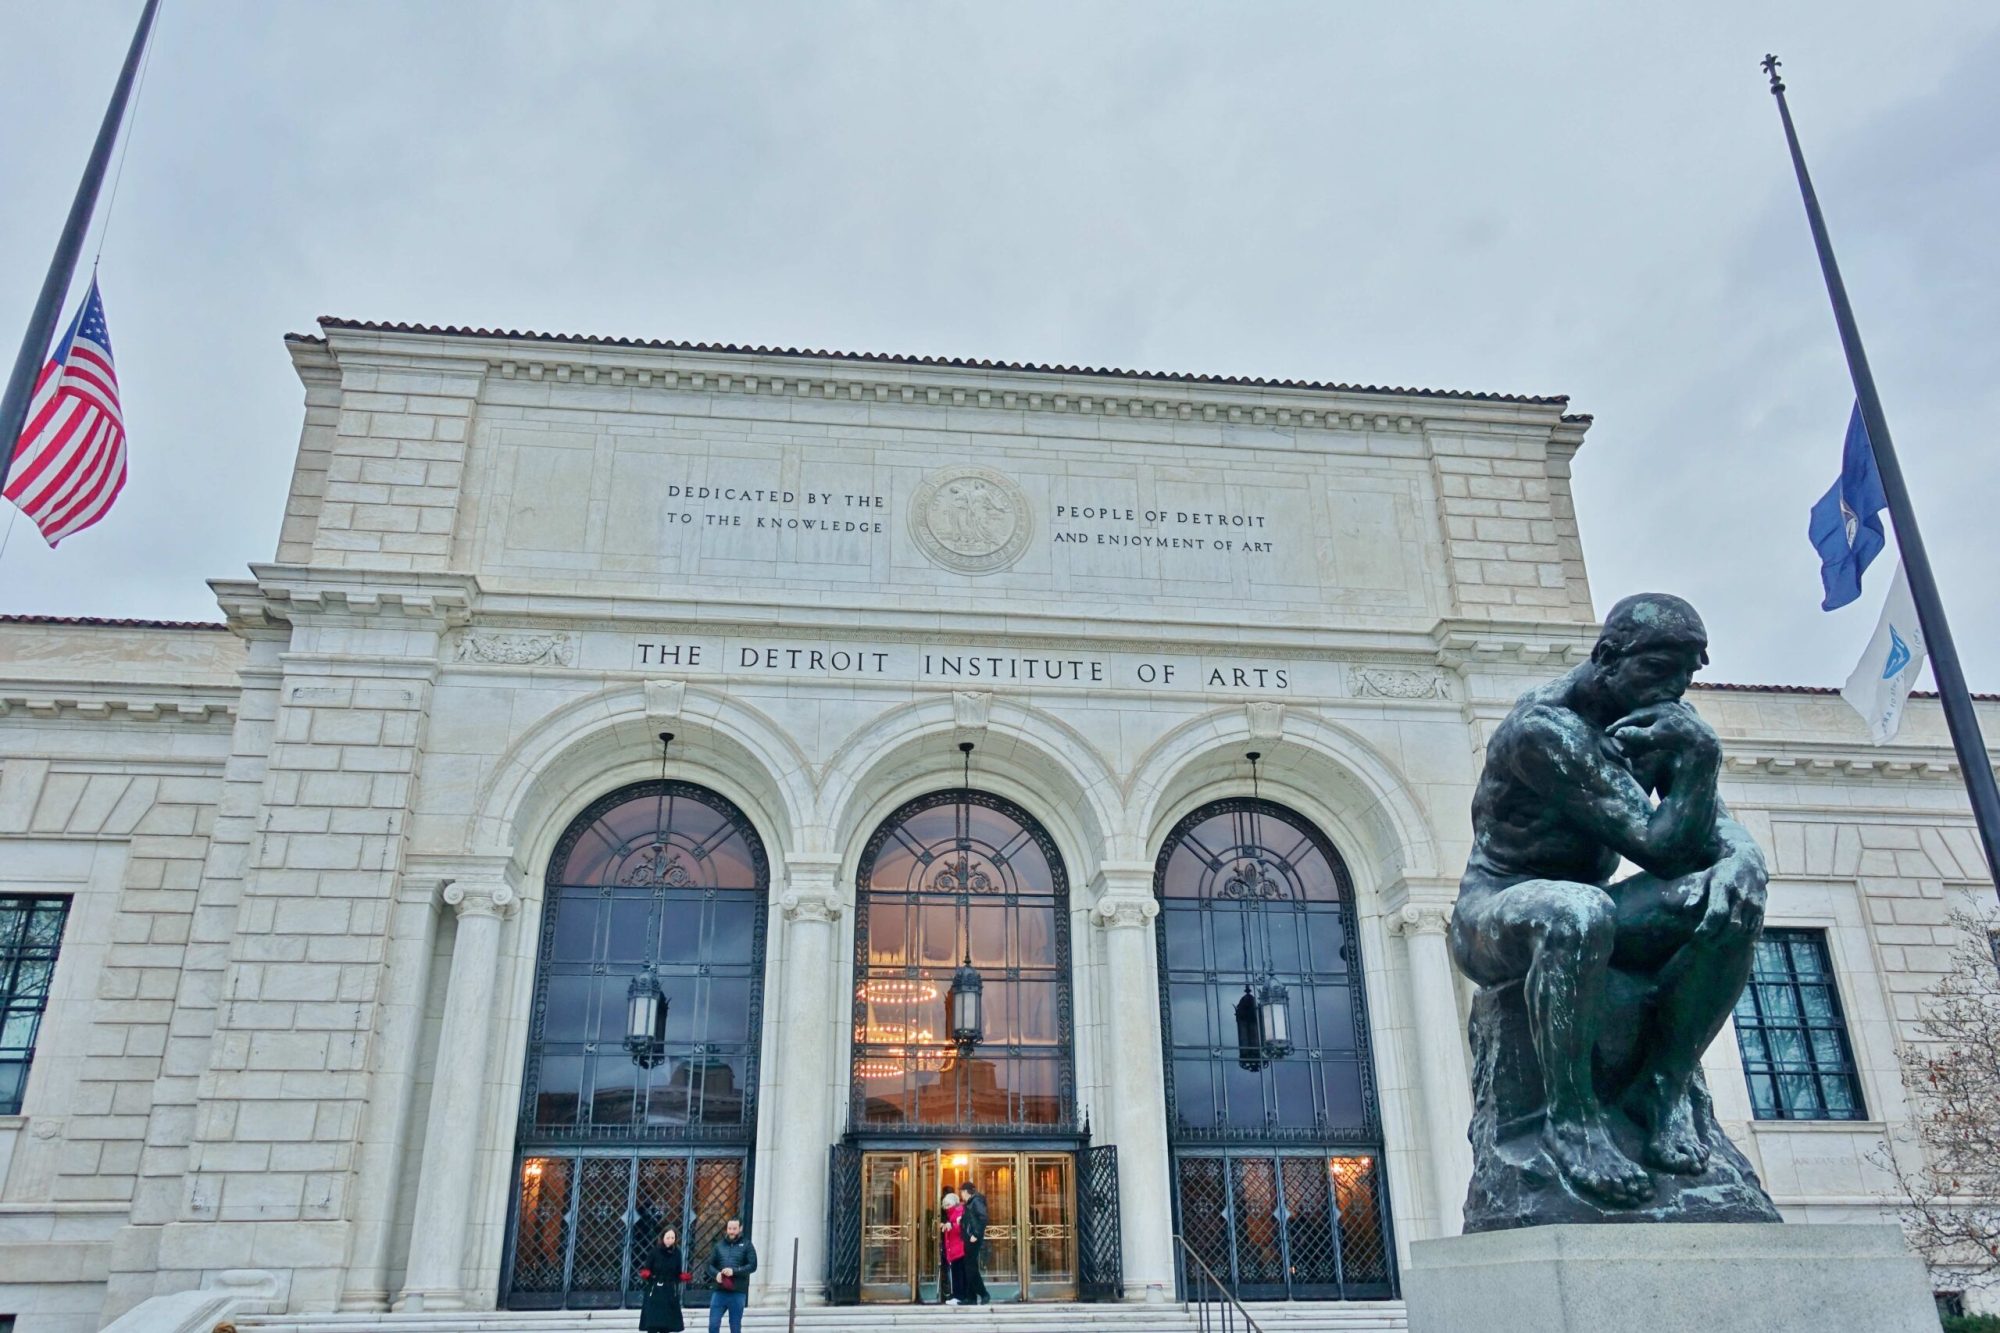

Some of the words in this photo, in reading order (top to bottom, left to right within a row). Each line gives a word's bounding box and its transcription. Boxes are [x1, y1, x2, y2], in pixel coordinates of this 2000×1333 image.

[668, 485, 795, 503] DEDICATED
[807, 492, 833, 505] BY
[844, 494, 884, 509] THE
[1056, 505, 1135, 521] PEOPLE
[1144, 510, 1168, 523] OF
[1176, 511, 1265, 528] DETROIT
[667, 512, 692, 524] TO
[705, 514, 741, 527] THE
[756, 517, 882, 534] KNOWLEDGE
[1053, 532, 1089, 544] AND
[1097, 533, 1205, 550] ENJOYMENT
[1213, 539, 1233, 551] OF
[1241, 541, 1273, 553] ART
[637, 643, 701, 666] THE
[740, 647, 889, 673] DETROIT
[925, 655, 1103, 682] INSTITUTE
[1137, 663, 1175, 684] OF
[1207, 667, 1288, 689] ARTS
